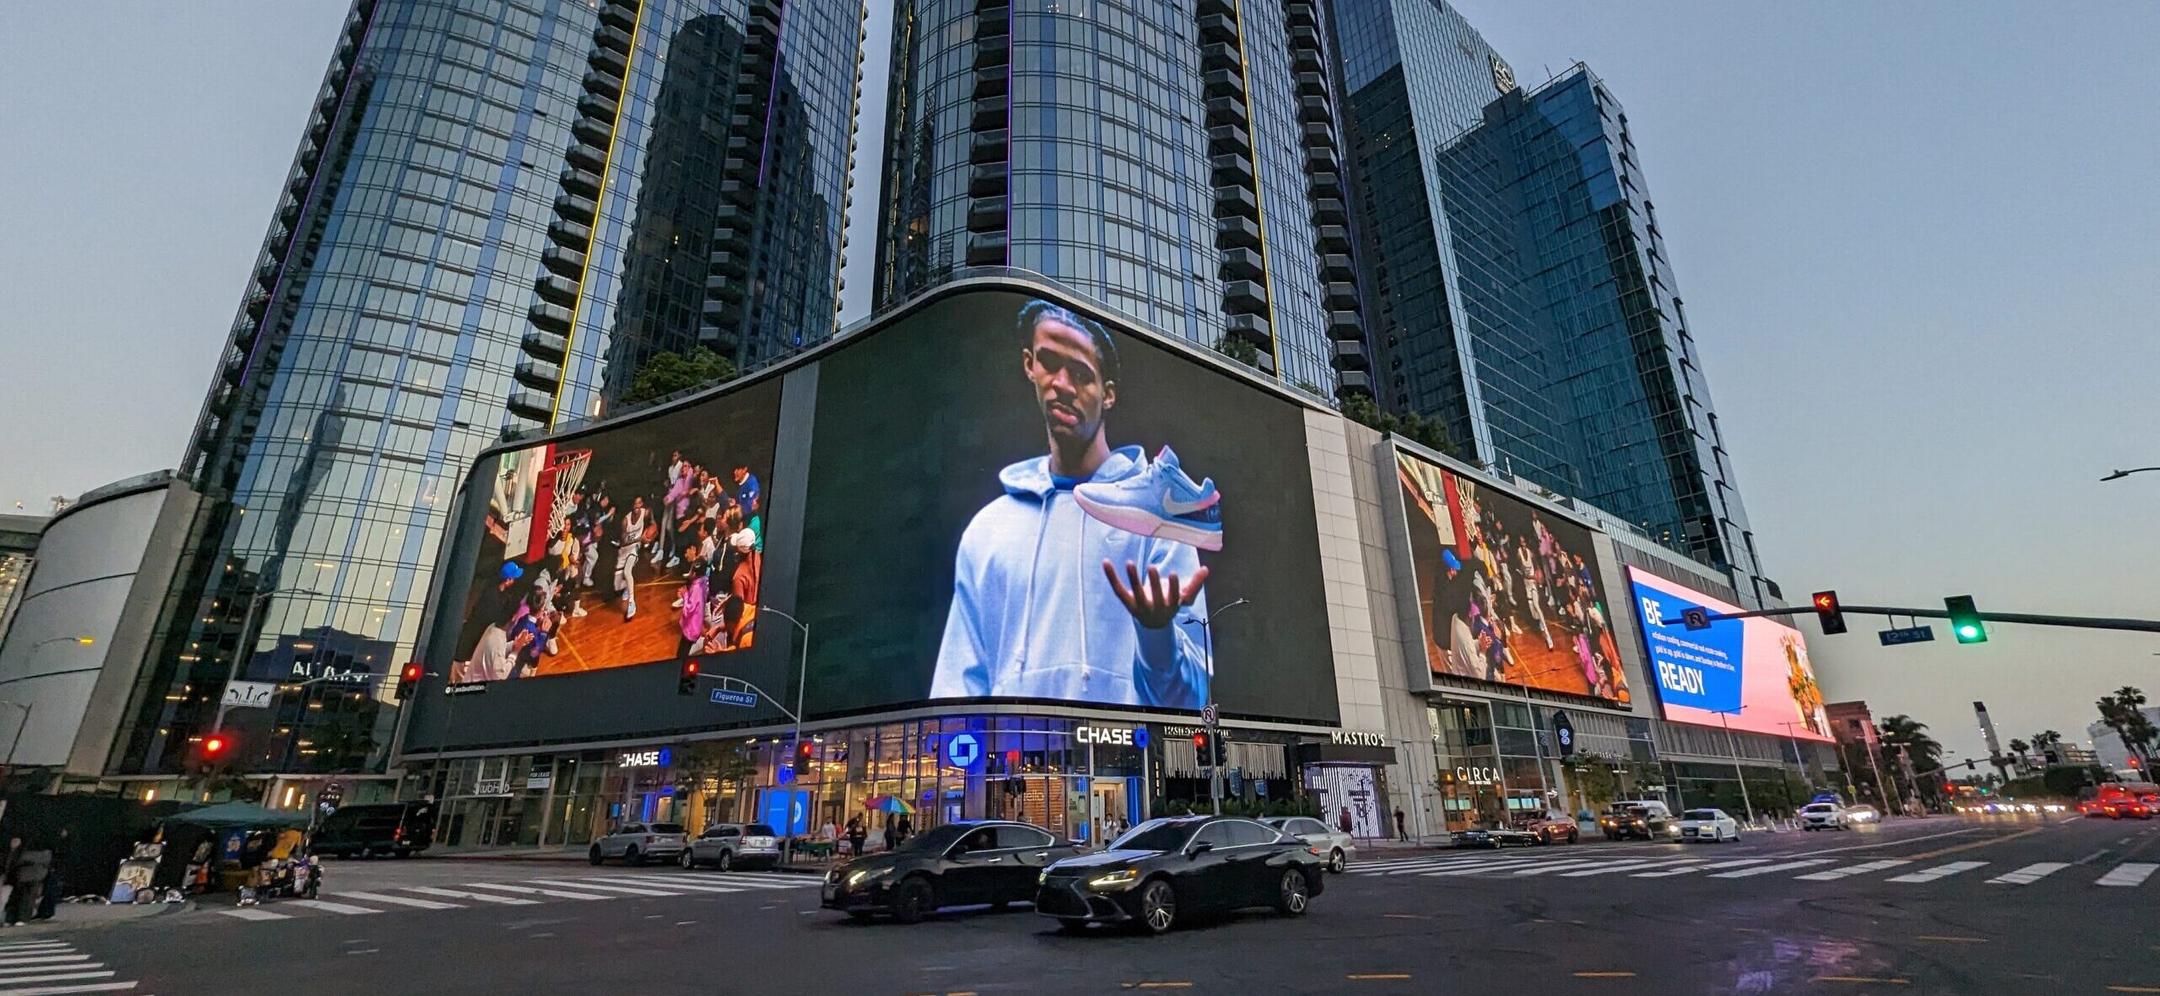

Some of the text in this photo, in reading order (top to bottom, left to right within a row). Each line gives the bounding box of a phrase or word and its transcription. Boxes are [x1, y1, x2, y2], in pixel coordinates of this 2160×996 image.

[1642, 597, 1666, 627] BE
[1658, 660, 1705, 696] READY
[715, 691, 753, 704] Figueroa St
[1077, 726, 1133, 745] CHASE
[1331, 731, 1385, 747] MASTRO'S
[1456, 766, 1500, 781] CIRCA
